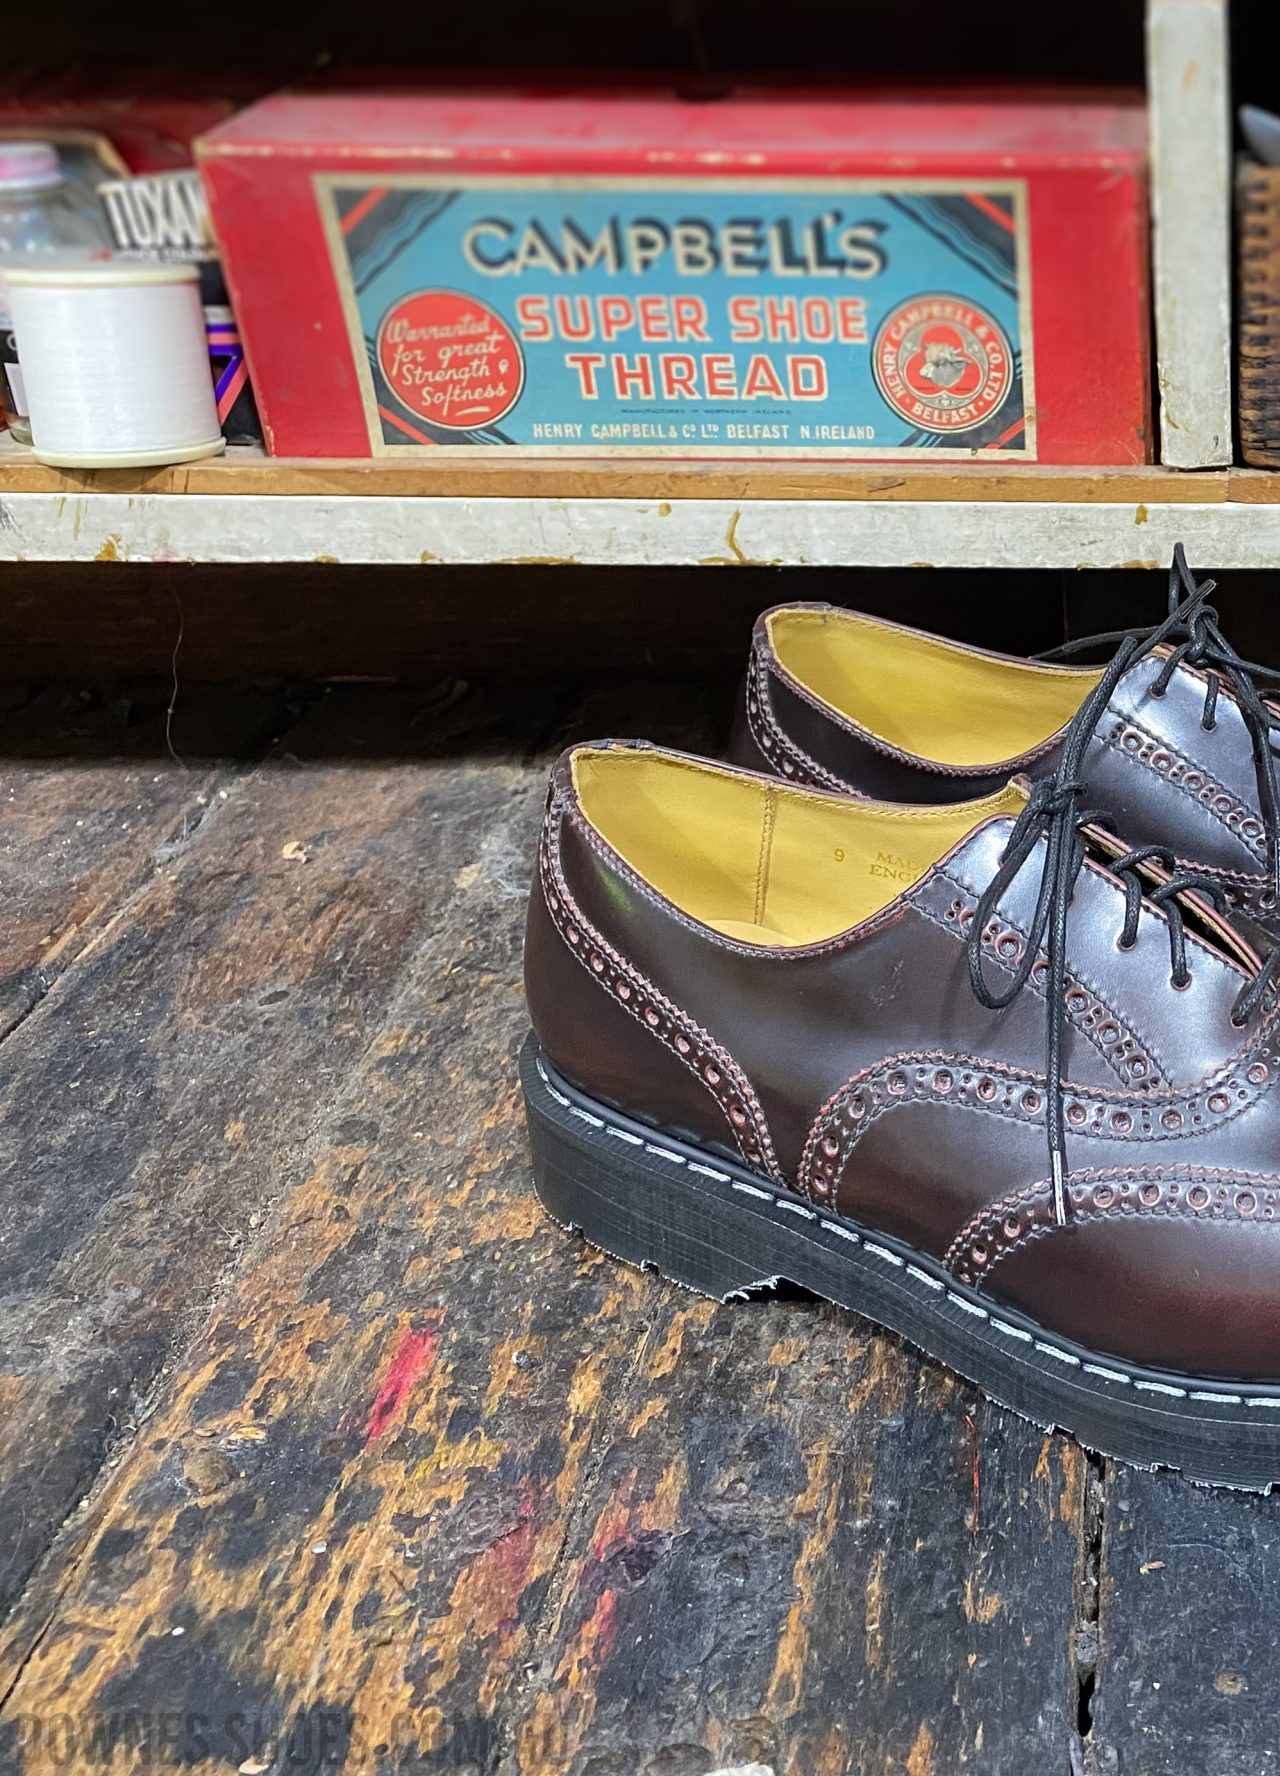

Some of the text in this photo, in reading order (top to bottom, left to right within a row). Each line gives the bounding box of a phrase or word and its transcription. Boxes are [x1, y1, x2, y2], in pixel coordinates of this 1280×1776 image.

[463, 207, 889, 281] CAMPBELL'S
[386, 312, 491, 343] Warranted
[516, 295, 868, 344] SUPER SHOE
[890, 304, 973, 340] CAMPBELL
[391, 330, 505, 377] for great
[402, 355, 490, 387] Strength
[565, 352, 829, 402] THREAD
[883, 343, 906, 398] HENRY
[421, 381, 508, 416] Softness
[911, 402, 979, 423] BELFAST
[533, 423, 583, 439] HENRY
[591, 423, 666, 440] CAMPBELL
[668, 425, 678, 439] &
[727, 425, 790, 439] BELFAST
[834, 848, 845, 862] 9
[875, 851, 920, 871] MAD
[869, 863, 917, 882] ENG
